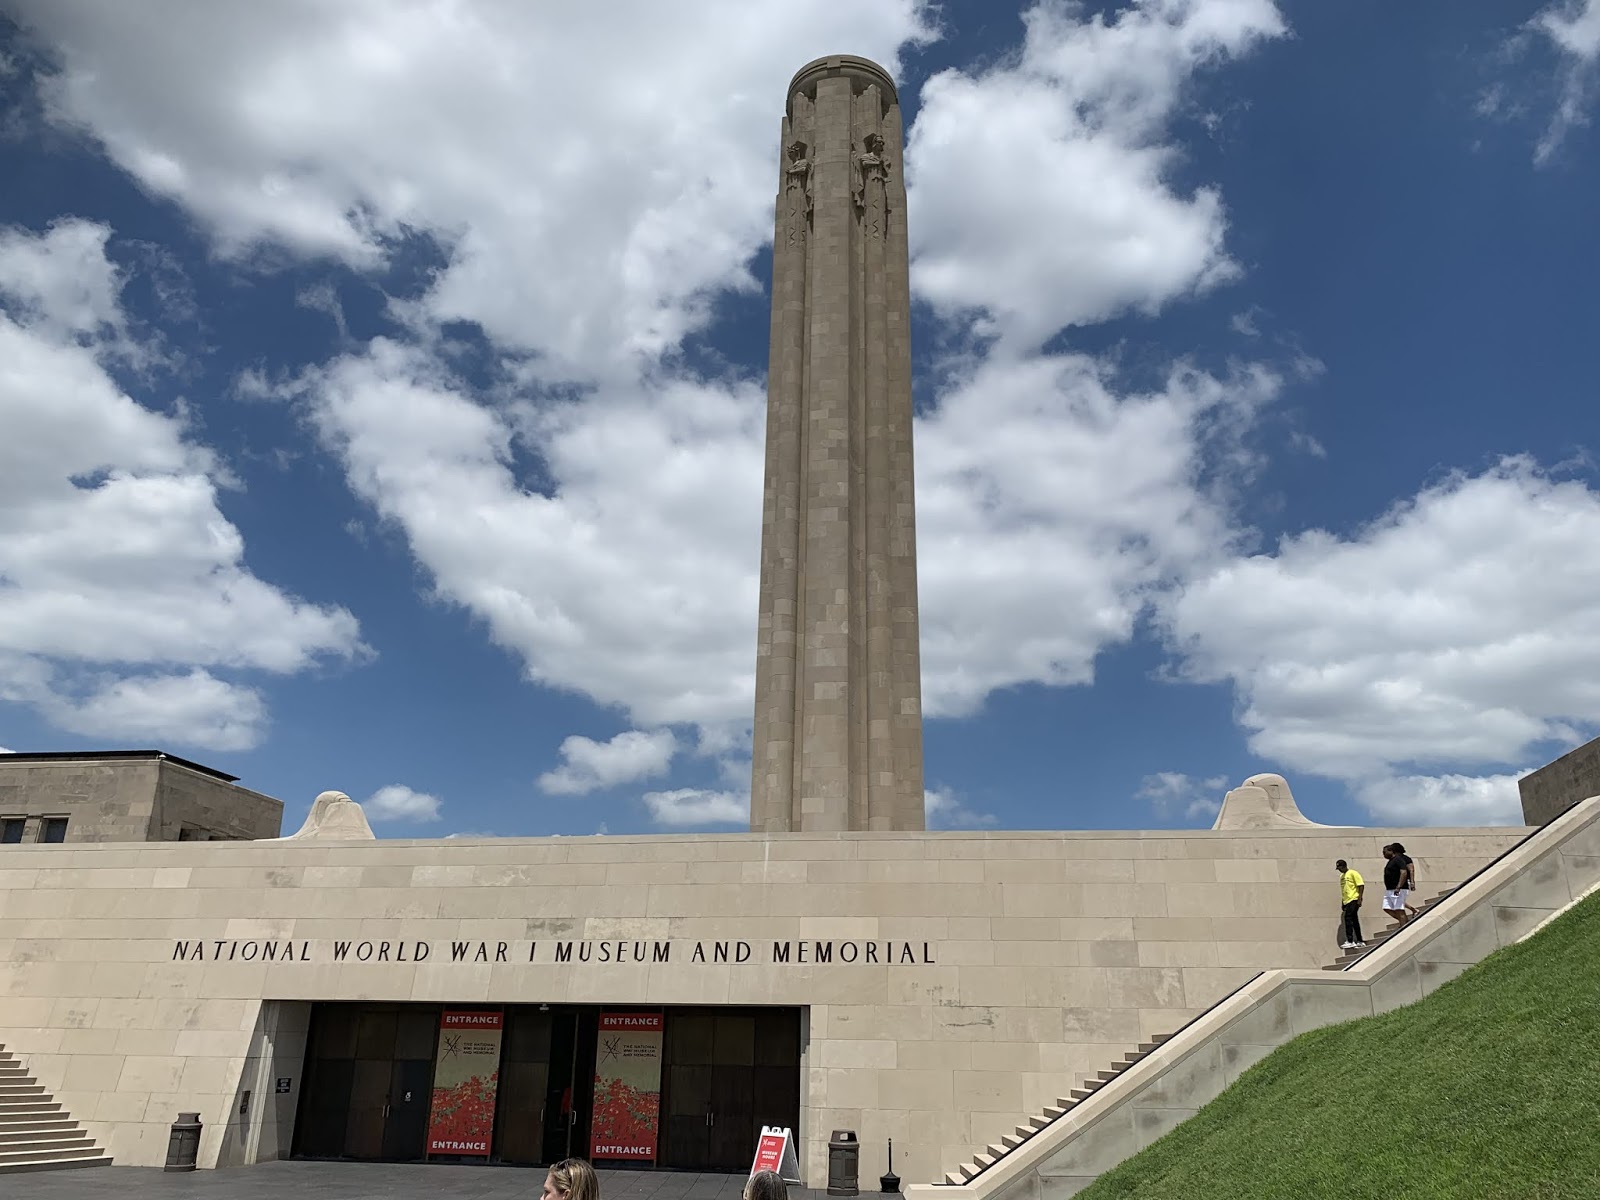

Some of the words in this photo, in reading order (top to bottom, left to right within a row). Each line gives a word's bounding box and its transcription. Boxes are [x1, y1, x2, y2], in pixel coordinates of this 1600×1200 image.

[172, 941, 311, 961] NATIONAL
[333, 941, 430, 962] WORLD
[451, 941, 508, 962] WAR
[528, 941, 536, 962] I
[554, 941, 672, 963] MUSEUM
[691, 941, 752, 963] AND
[772, 941, 936, 963] MEMORIAL
[445, 1015, 499, 1024] ENTRANCE
[603, 1017, 659, 1026] ENTRANCE
[432, 1140, 486, 1150] ENTRANCE
[595, 1145, 652, 1155] ENTRANCE
